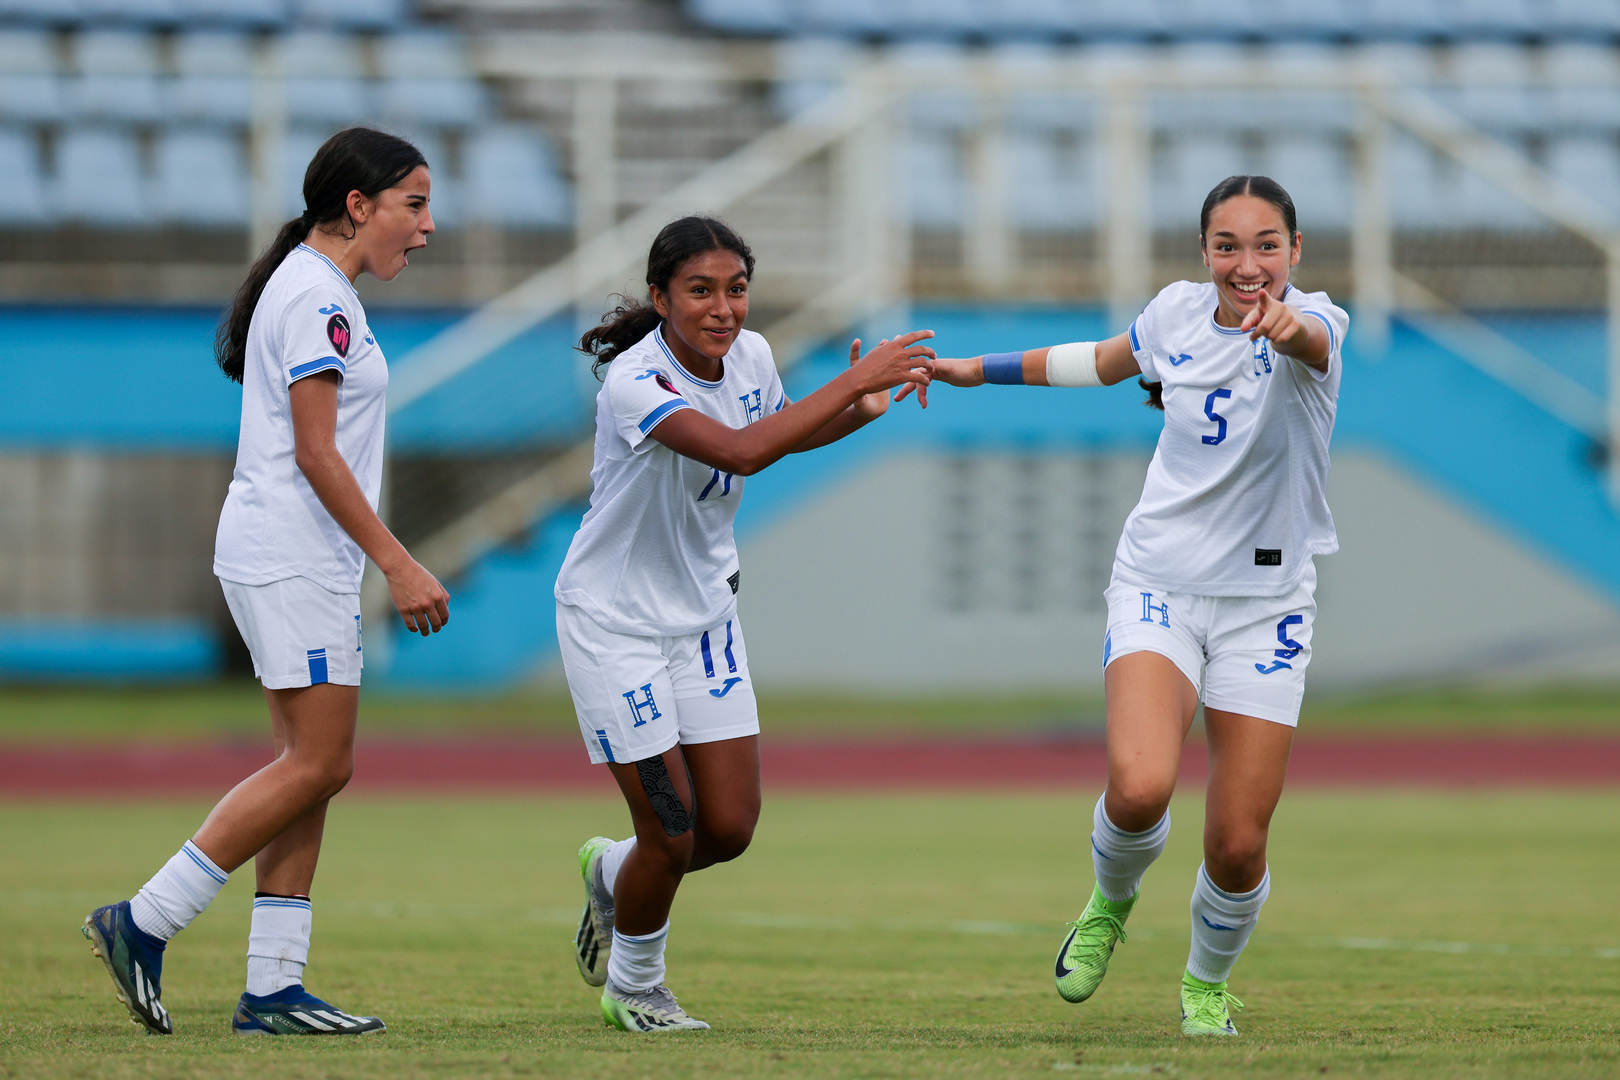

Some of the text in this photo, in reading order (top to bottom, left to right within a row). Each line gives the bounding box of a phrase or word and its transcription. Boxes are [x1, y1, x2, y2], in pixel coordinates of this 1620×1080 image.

[1251, 337, 1272, 377] H
[738, 388, 763, 425] H
[1202, 388, 1232, 446] 5
[1271, 554, 1279, 563] H
[1139, 592, 1171, 629] H
[700, 620, 738, 679] 11
[1274, 615, 1304, 660] 5
[622, 682, 662, 728] H
